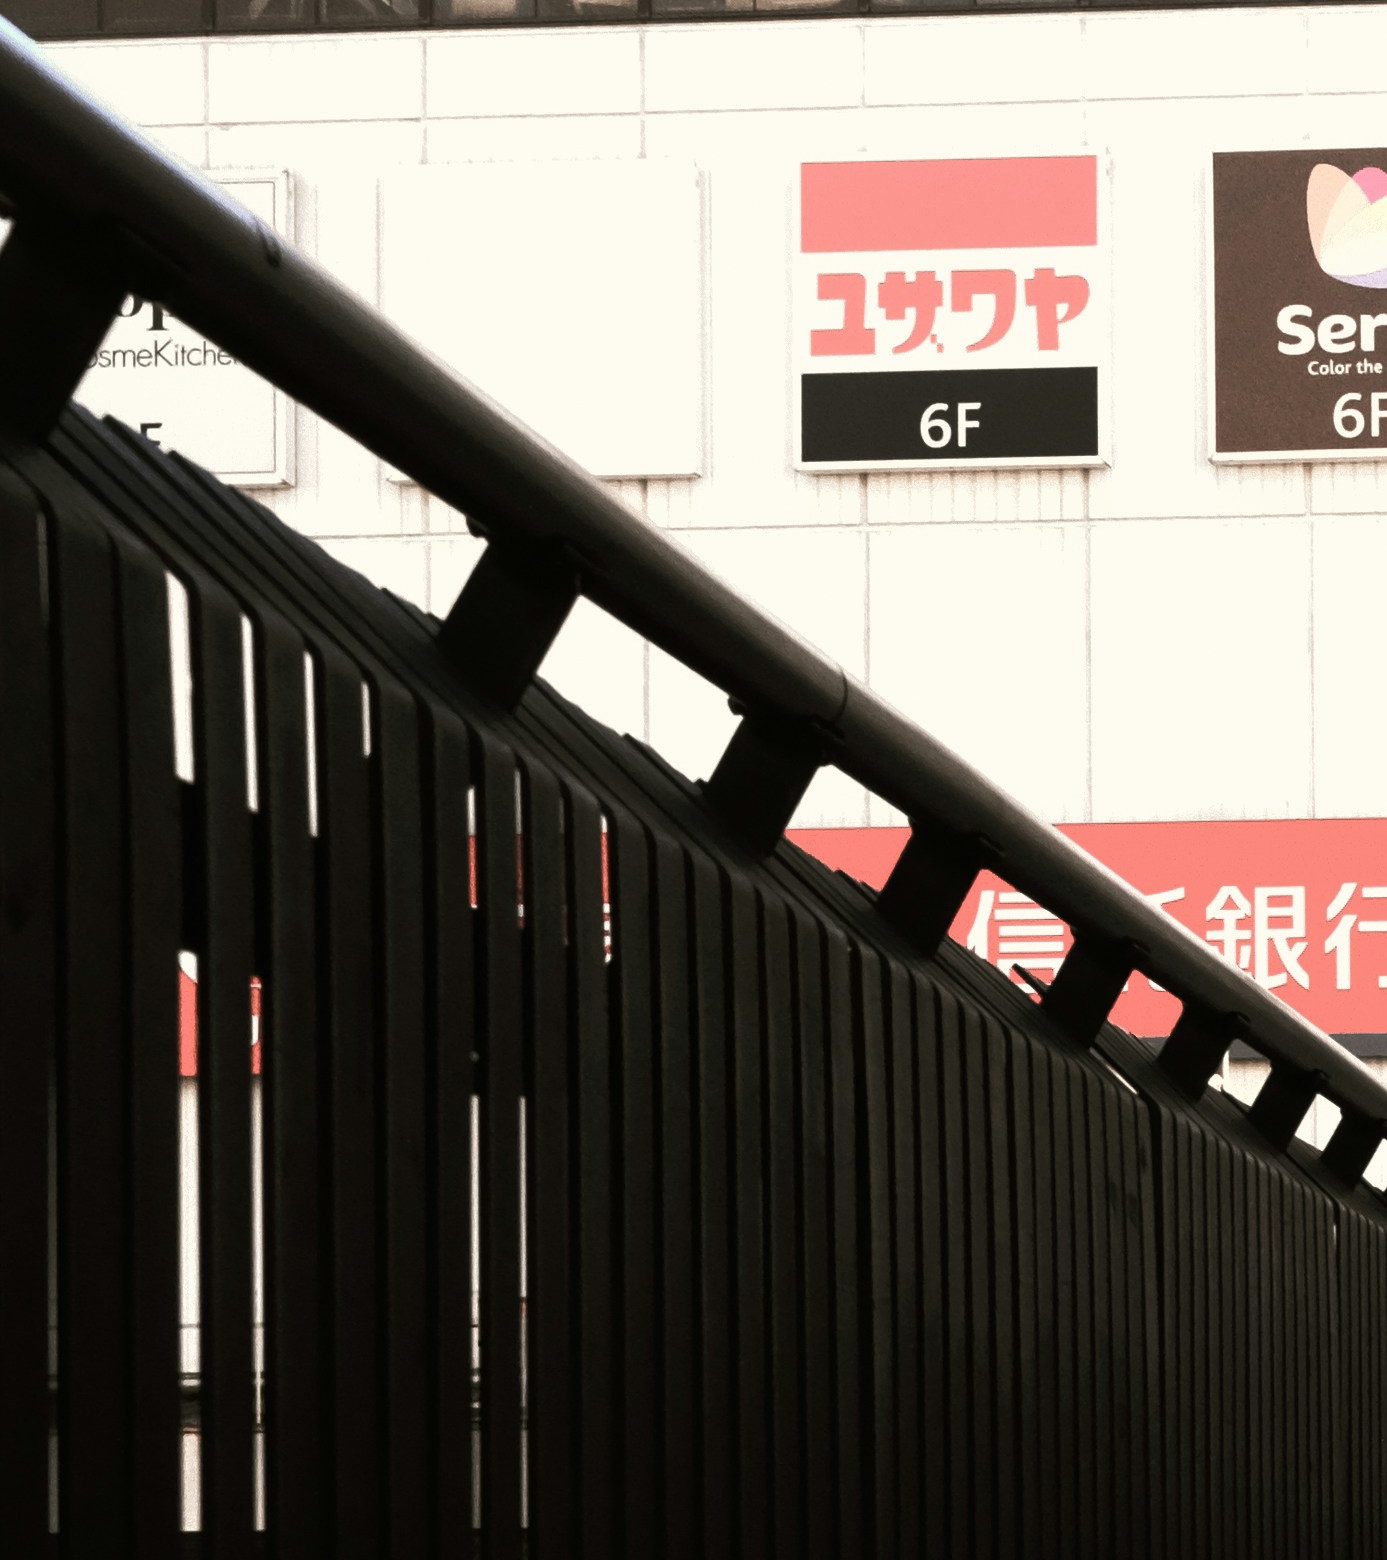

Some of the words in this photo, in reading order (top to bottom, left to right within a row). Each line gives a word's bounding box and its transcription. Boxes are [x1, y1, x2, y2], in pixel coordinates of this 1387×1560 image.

[88, 339, 239, 369] smeKitche
[1307, 359, 1352, 376] Color
[1356, 358, 1383, 374] the
[920, 401, 982, 449] 6F
